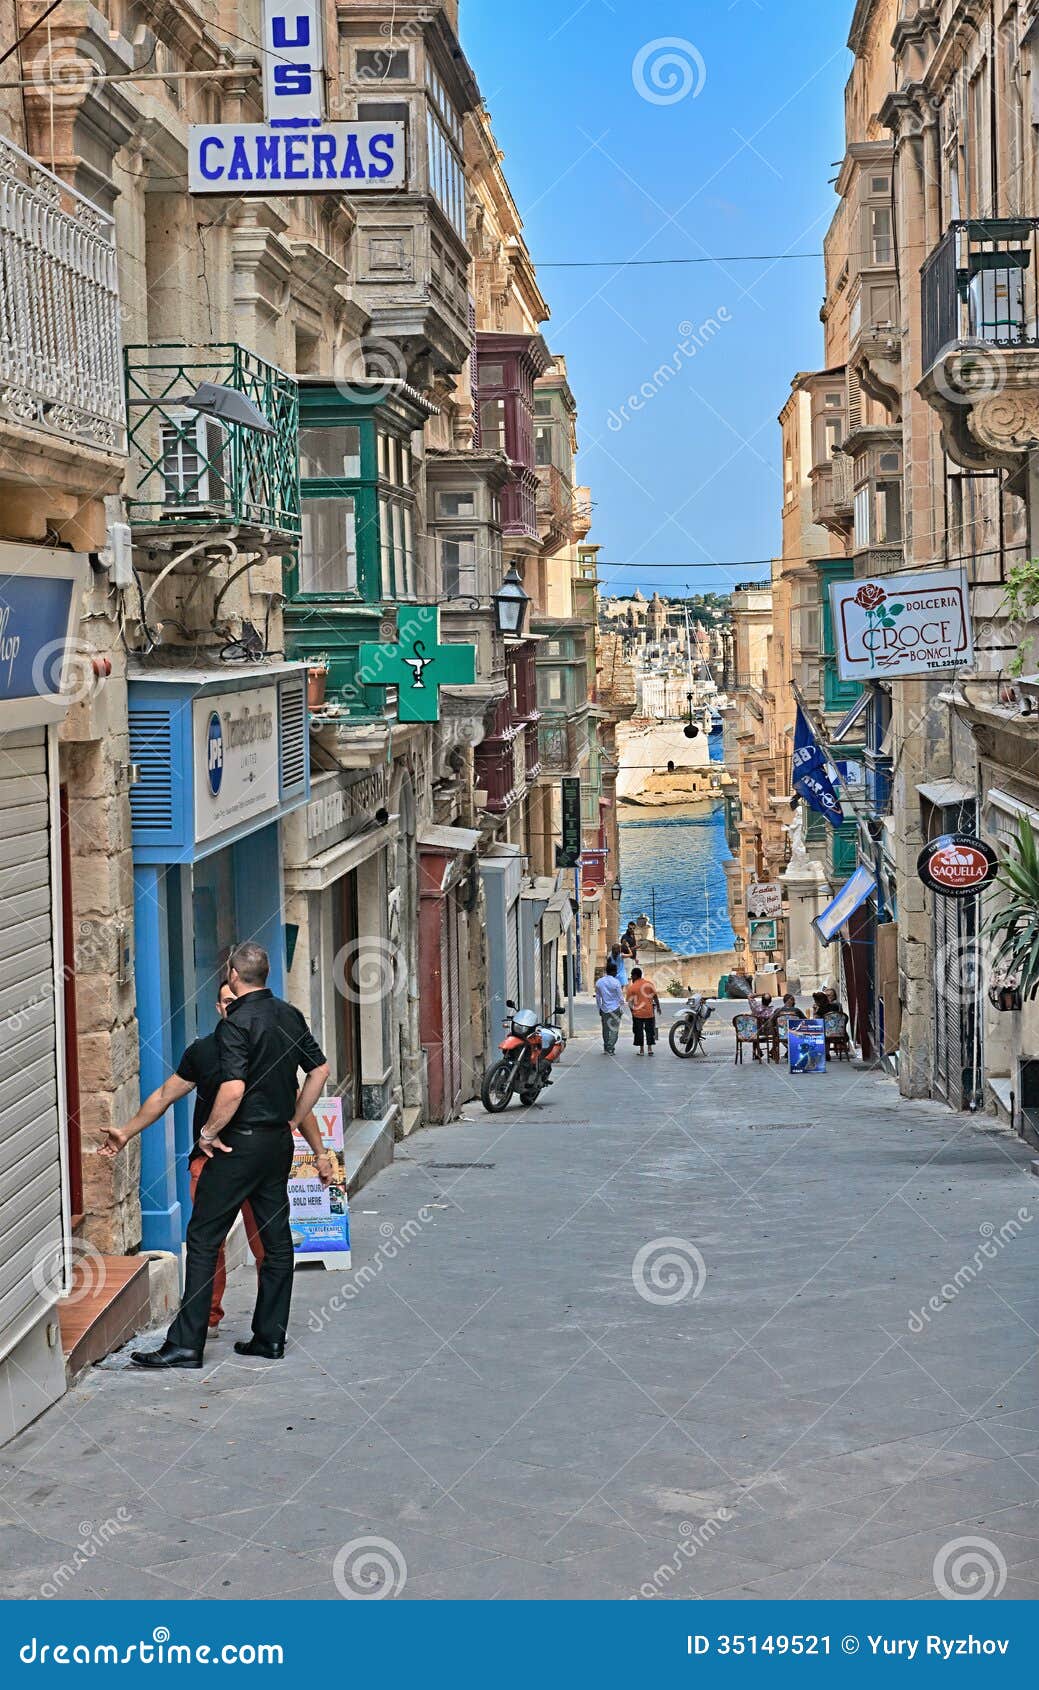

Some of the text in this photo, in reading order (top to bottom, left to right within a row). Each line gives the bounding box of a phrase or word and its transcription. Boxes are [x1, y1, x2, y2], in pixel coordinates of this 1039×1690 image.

[199, 133, 395, 181] CAMERAS
[906, 597, 958, 612] DOLCERIA
[862, 620, 952, 652] CROCE
[909, 647, 952, 662] BONACI
[209, 737, 223, 771] JPE
[932, 865, 984, 879] SAQUELLA
[288, 1184, 306, 1194] LOCAL
[293, 1196, 322, 1206] SOLD HERE
